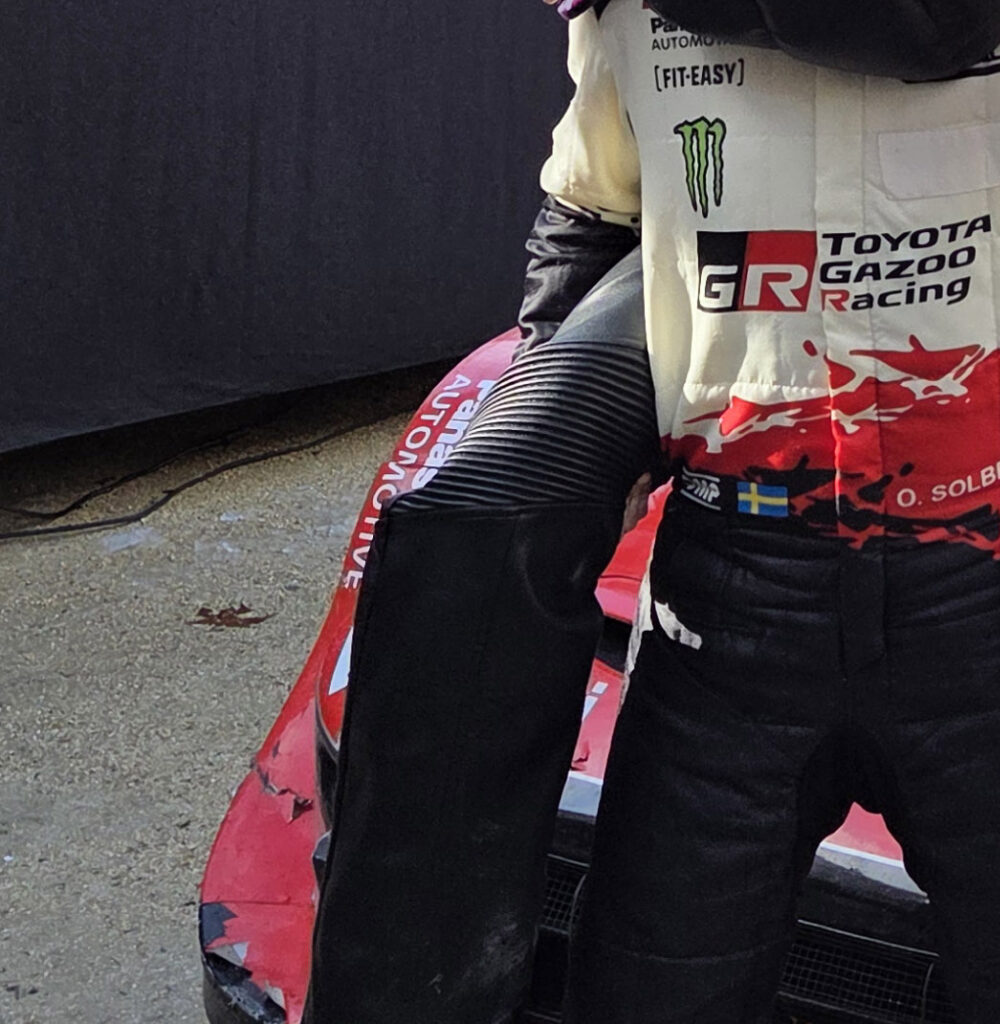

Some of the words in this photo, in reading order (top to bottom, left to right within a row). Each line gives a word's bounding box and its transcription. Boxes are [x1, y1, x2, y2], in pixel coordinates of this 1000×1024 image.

[822, 214, 992, 256] TOYOTA
[819, 245, 976, 284] GAZOO
[699, 263, 809, 309] GR
[821, 276, 971, 312] Racing
[896, 488, 922, 508] O.
